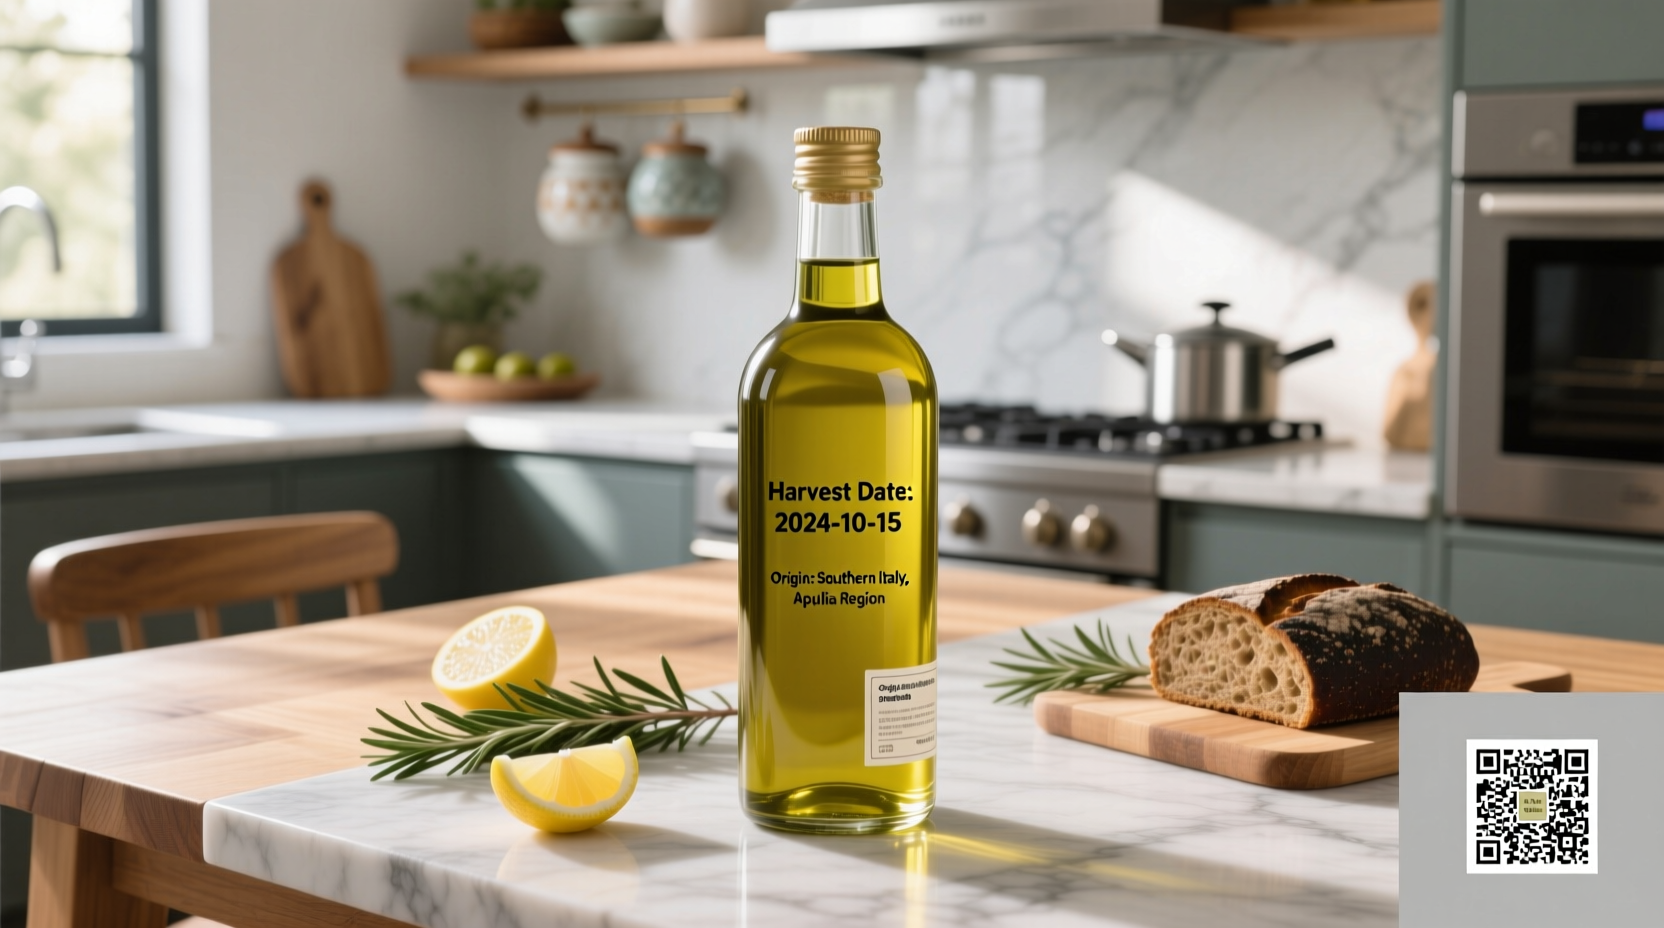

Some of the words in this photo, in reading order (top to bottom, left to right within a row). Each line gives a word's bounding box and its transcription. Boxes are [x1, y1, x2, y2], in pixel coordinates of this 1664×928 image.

[768, 481, 851, 502] Harvest
[858, 481, 914, 502] Date:
[775, 511, 902, 533] 2024-10-15
[770, 571, 815, 588] Origin:
[817, 570, 876, 585] Southern
[879, 570, 910, 587] Italy,
[793, 591, 837, 609] Apulia
[840, 591, 886, 609] Region
